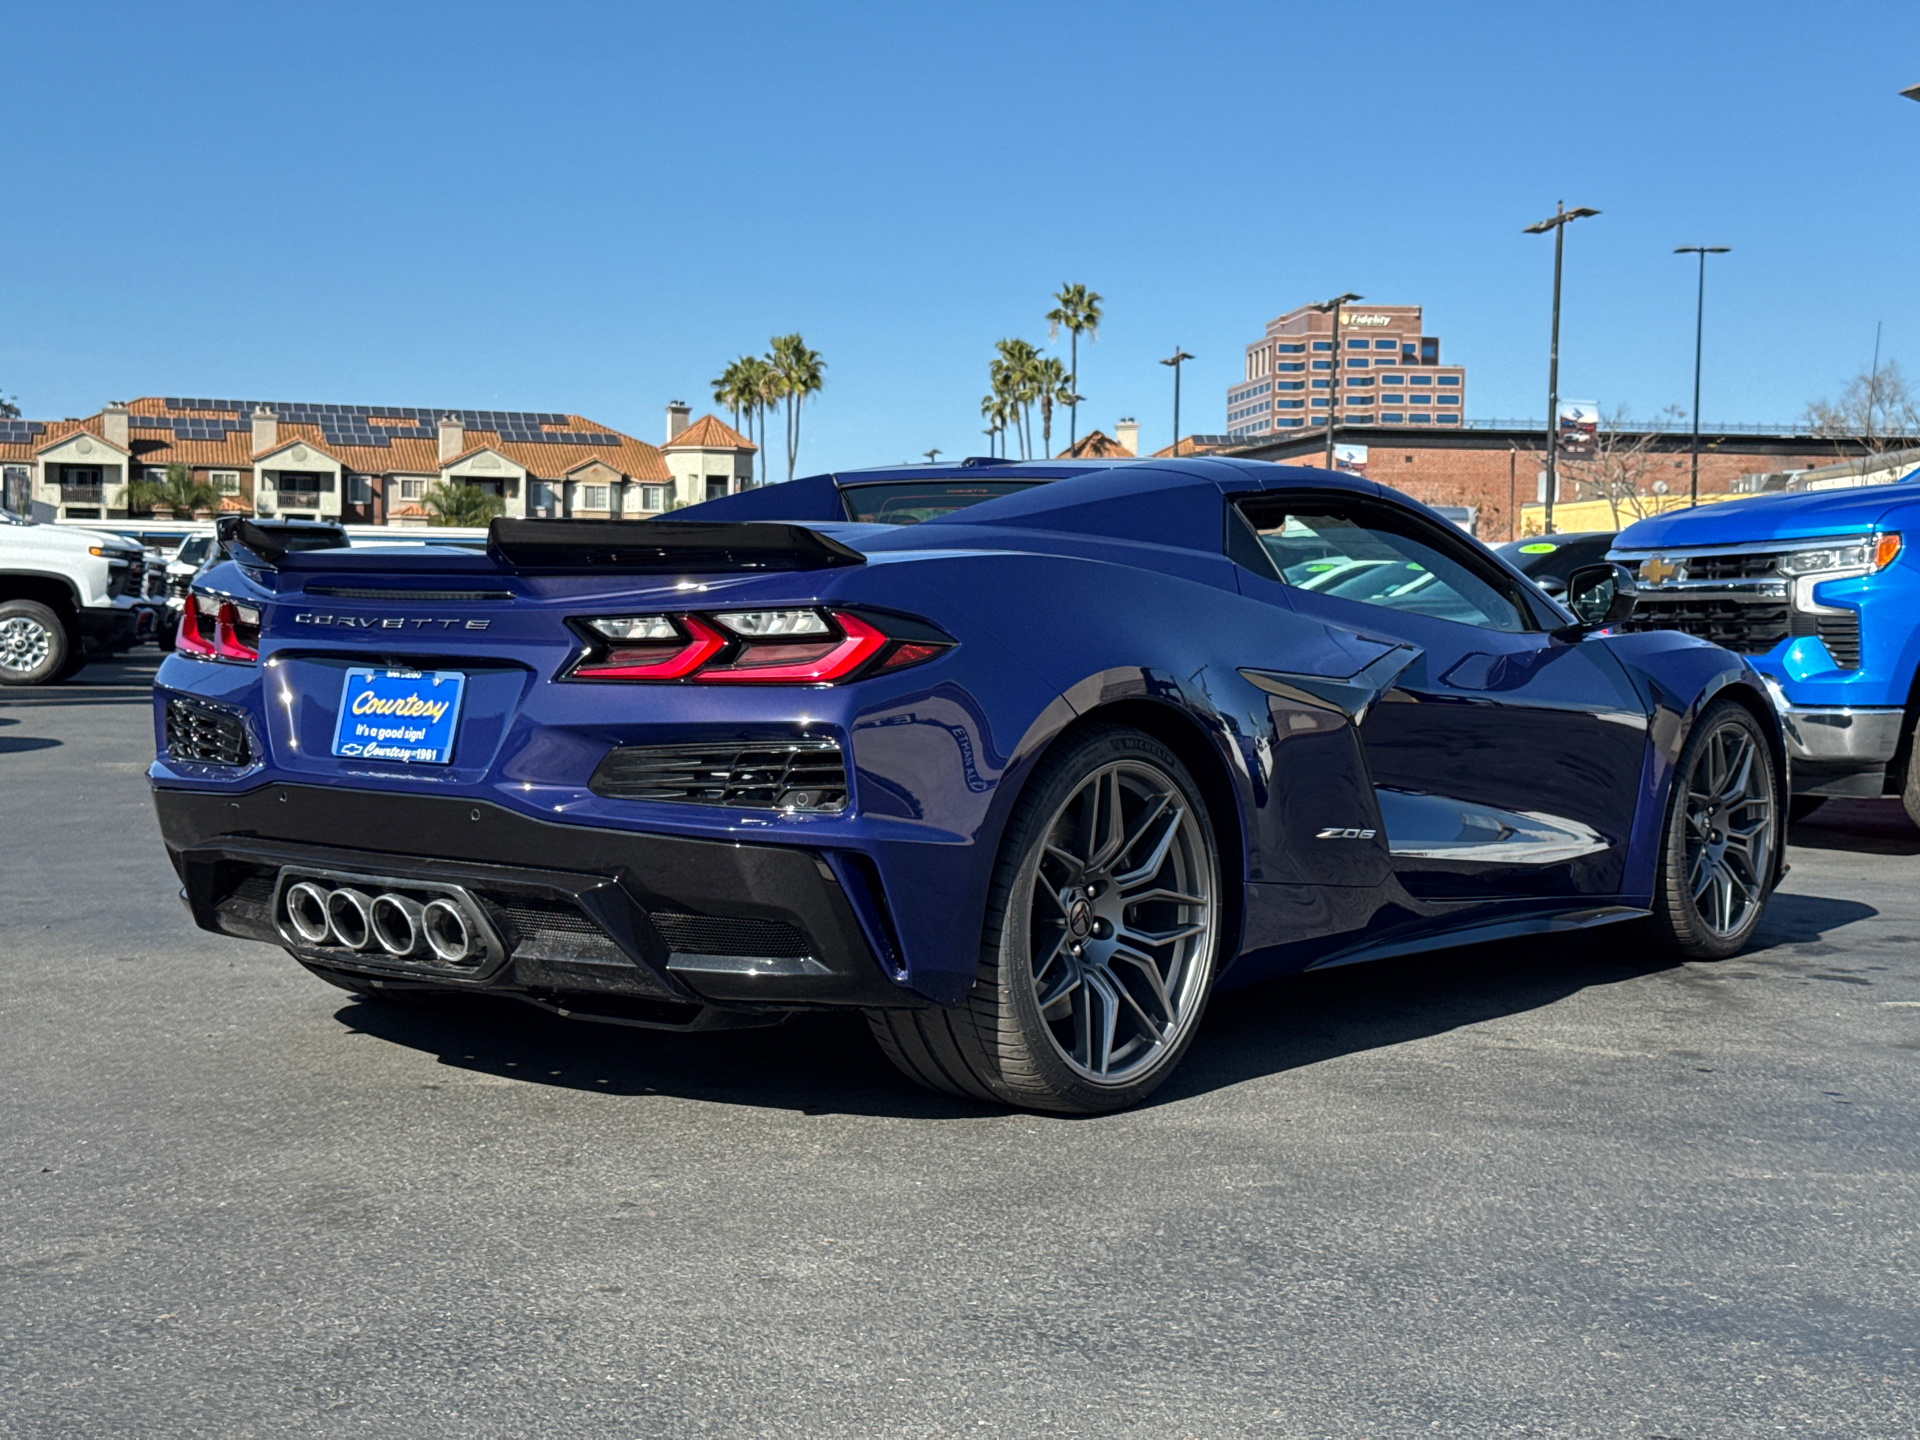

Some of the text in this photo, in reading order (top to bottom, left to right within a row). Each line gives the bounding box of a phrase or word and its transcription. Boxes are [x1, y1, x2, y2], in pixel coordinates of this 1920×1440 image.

[1351, 313, 1391, 326] Fidelity
[295, 613, 491, 630] CORVETTE
[352, 690, 450, 724] Courtesy
[355, 723, 426, 742] It's a good sign!
[363, 742, 412, 762] Courtesy
[416, 748, 437, 761] 1961
[1125, 738, 1174, 765] MICHELIN
[1315, 827, 1377, 839] Z06
